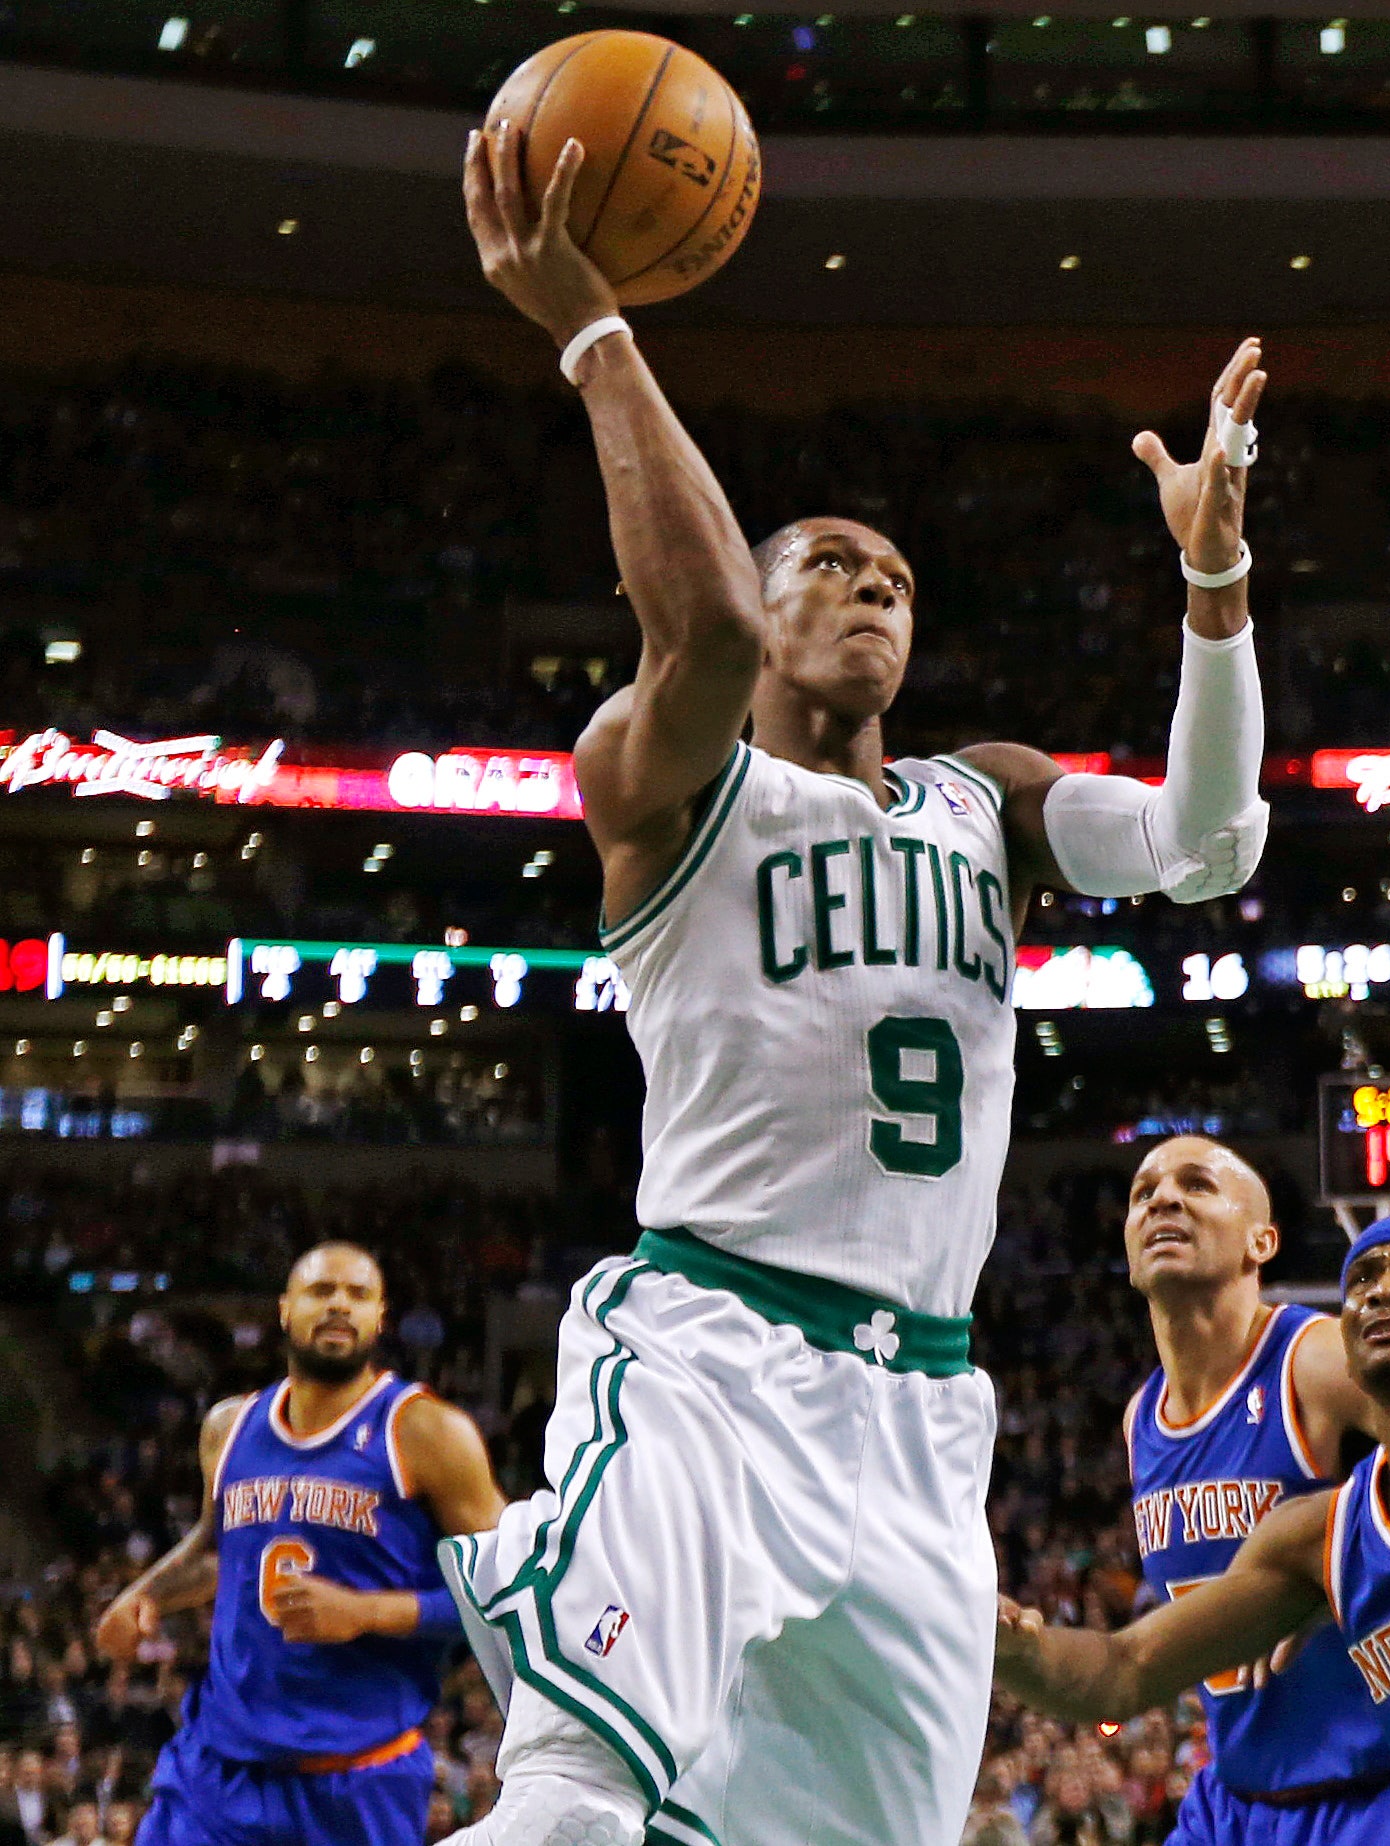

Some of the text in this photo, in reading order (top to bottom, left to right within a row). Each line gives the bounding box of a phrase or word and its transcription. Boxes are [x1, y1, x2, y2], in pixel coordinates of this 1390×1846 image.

[757, 835, 1008, 1005] CELTICS
[1182, 951, 1250, 1001] 16
[867, 1015, 965, 1179] 9
[222, 1475, 380, 1538] NEW YORK
